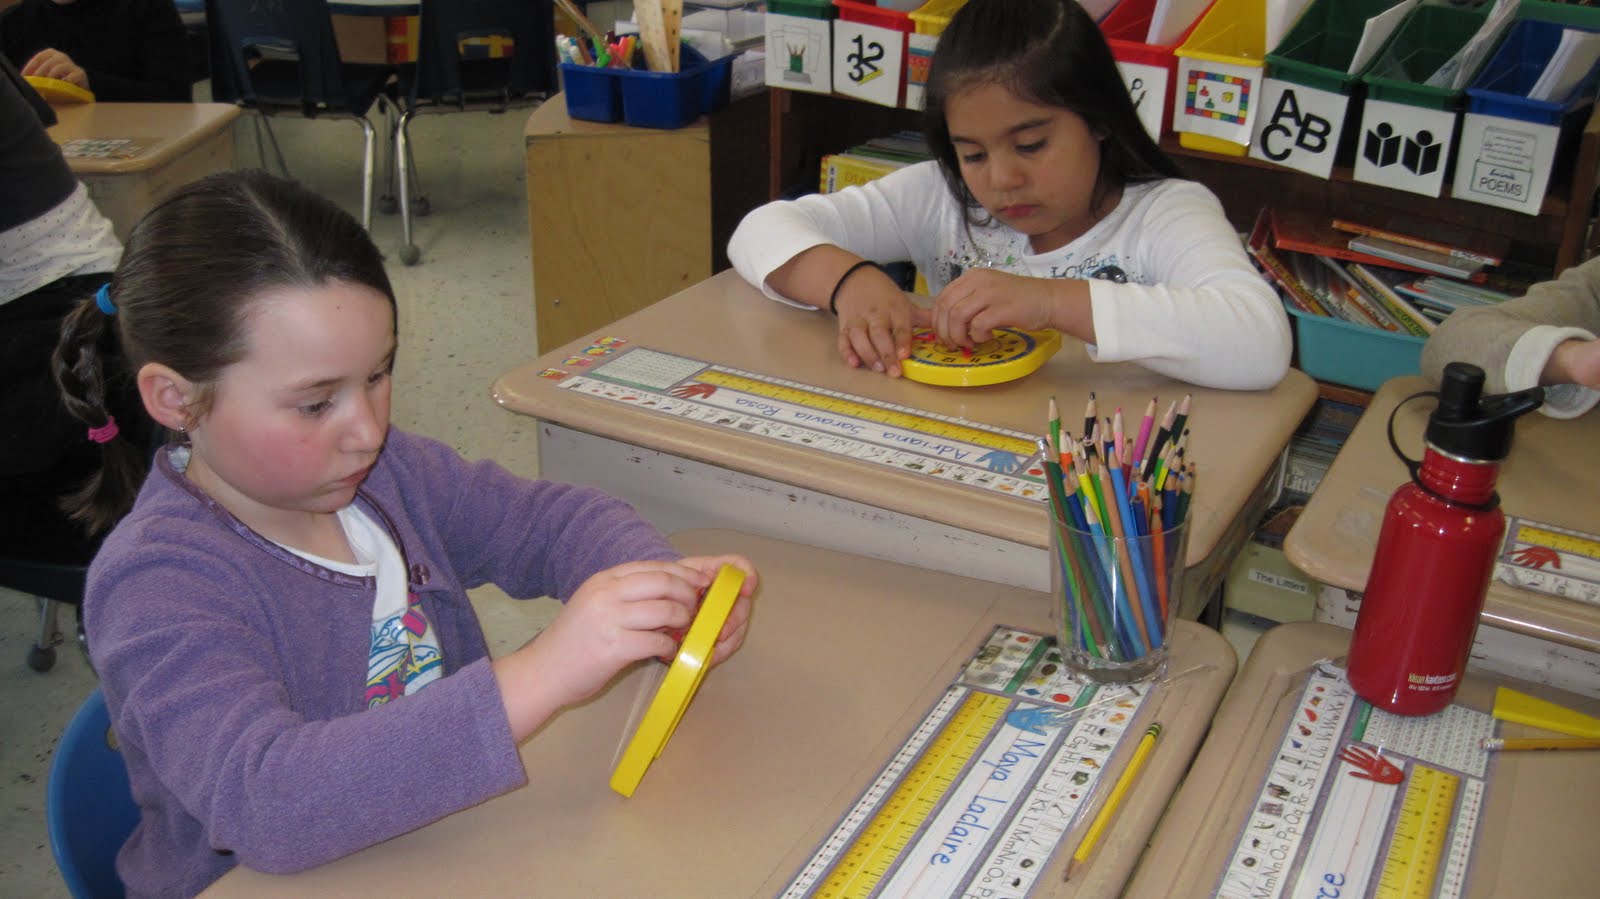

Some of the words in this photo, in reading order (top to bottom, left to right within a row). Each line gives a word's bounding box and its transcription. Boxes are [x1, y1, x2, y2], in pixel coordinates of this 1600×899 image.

[1479, 176, 1523, 197] POEMS
[1050, 252, 1101, 280] LOVE
[735, 397, 782, 417] Rosa
[794, 411, 865, 436] Saravia
[882, 431, 972, 461] Adriana
[1255, 571, 1274, 584] The
[982, 738, 1046, 781] Maya
[930, 795, 1008, 866] Laclaire
